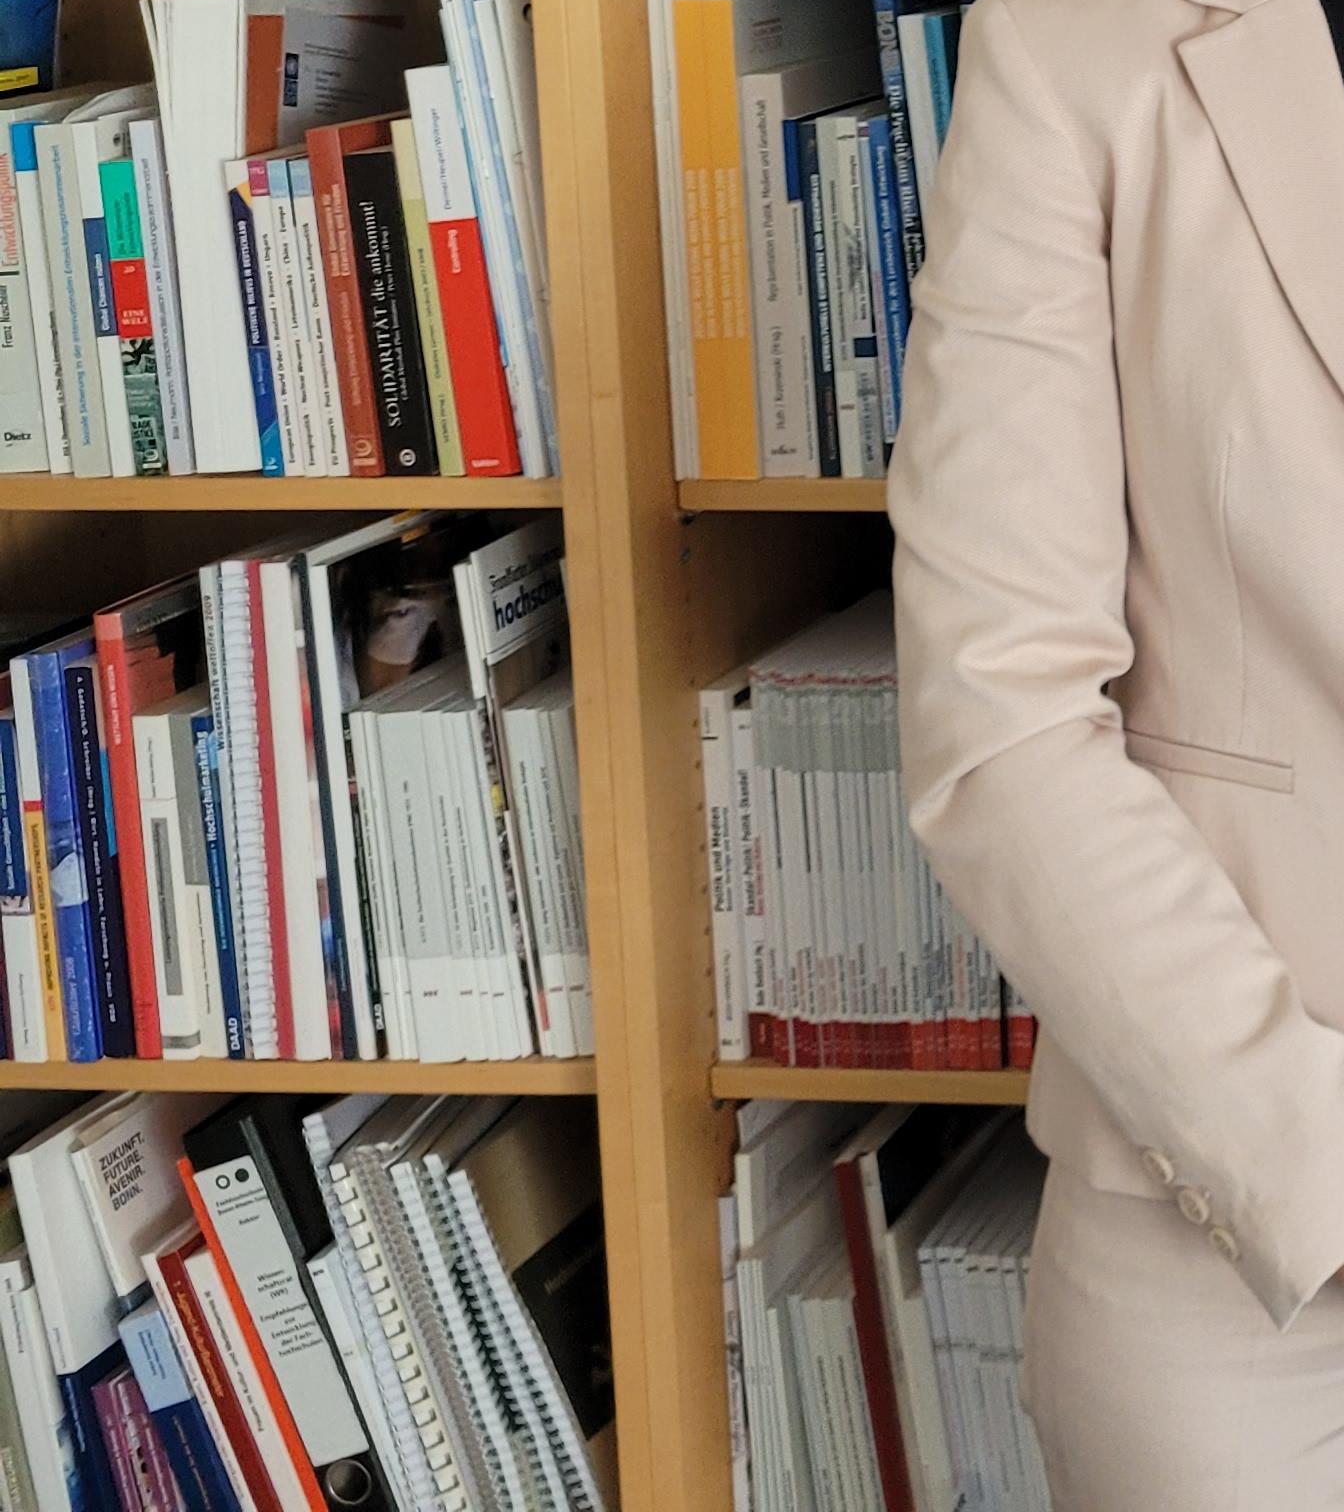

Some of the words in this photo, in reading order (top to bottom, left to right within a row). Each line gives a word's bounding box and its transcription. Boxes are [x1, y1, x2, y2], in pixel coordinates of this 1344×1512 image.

[358, 200, 385, 282] ankommt!
[369, 283, 386, 305] die
[374, 305, 402, 428] SOLIDARITÄT
[195, 730, 218, 842] Hochschulmarketing
[230, 1017, 241, 1051] DAAD
[98, 1131, 145, 1170] ZUKUNFT.
[103, 1149, 145, 1182] FUTURE.
[108, 1165, 146, 1199] AVENIR.
[111, 1185, 143, 1212] BONN.
